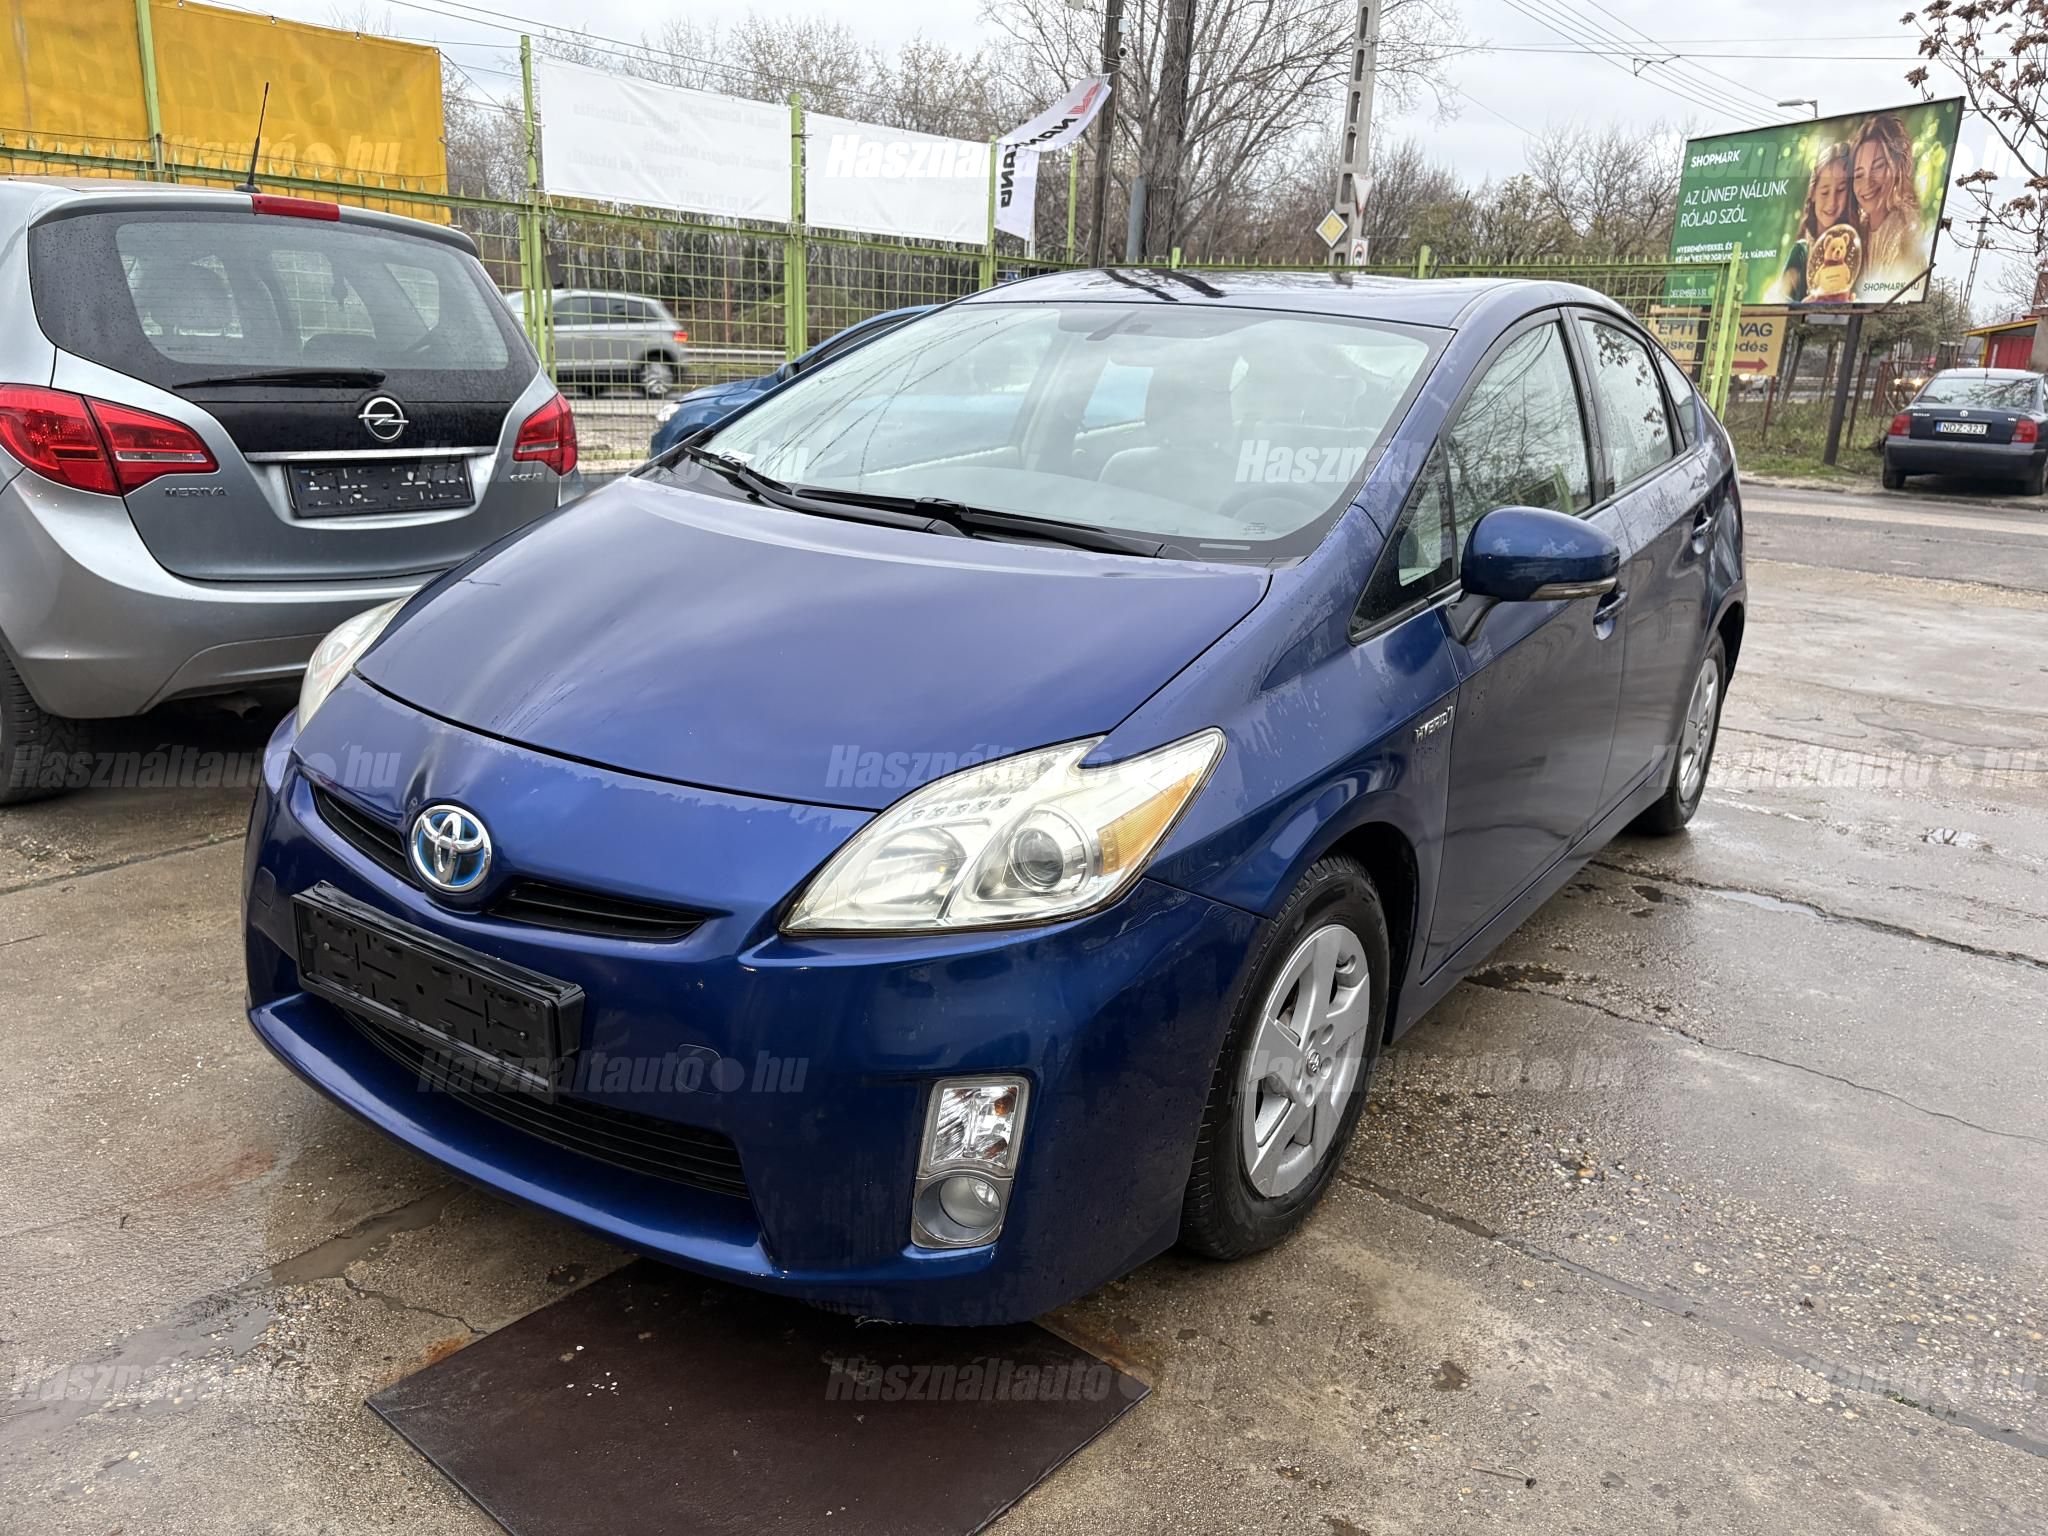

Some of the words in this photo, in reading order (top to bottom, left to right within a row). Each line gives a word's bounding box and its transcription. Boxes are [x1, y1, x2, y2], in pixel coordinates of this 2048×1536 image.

[1690, 150, 1741, 168] SHOPMARK
[1683, 191, 1699, 206] AZ
[1701, 184, 1738, 205] ÜNNEP
[1739, 179, 1790, 200] NÁLUNK
[1680, 209, 1718, 228] RÓLAD
[1719, 204, 1748, 223] SZÓL
[1725, 240, 1734, 251] ÉS
[1943, 422, 1986, 433] NDZ-323
[164, 486, 229, 498] MERIVA
